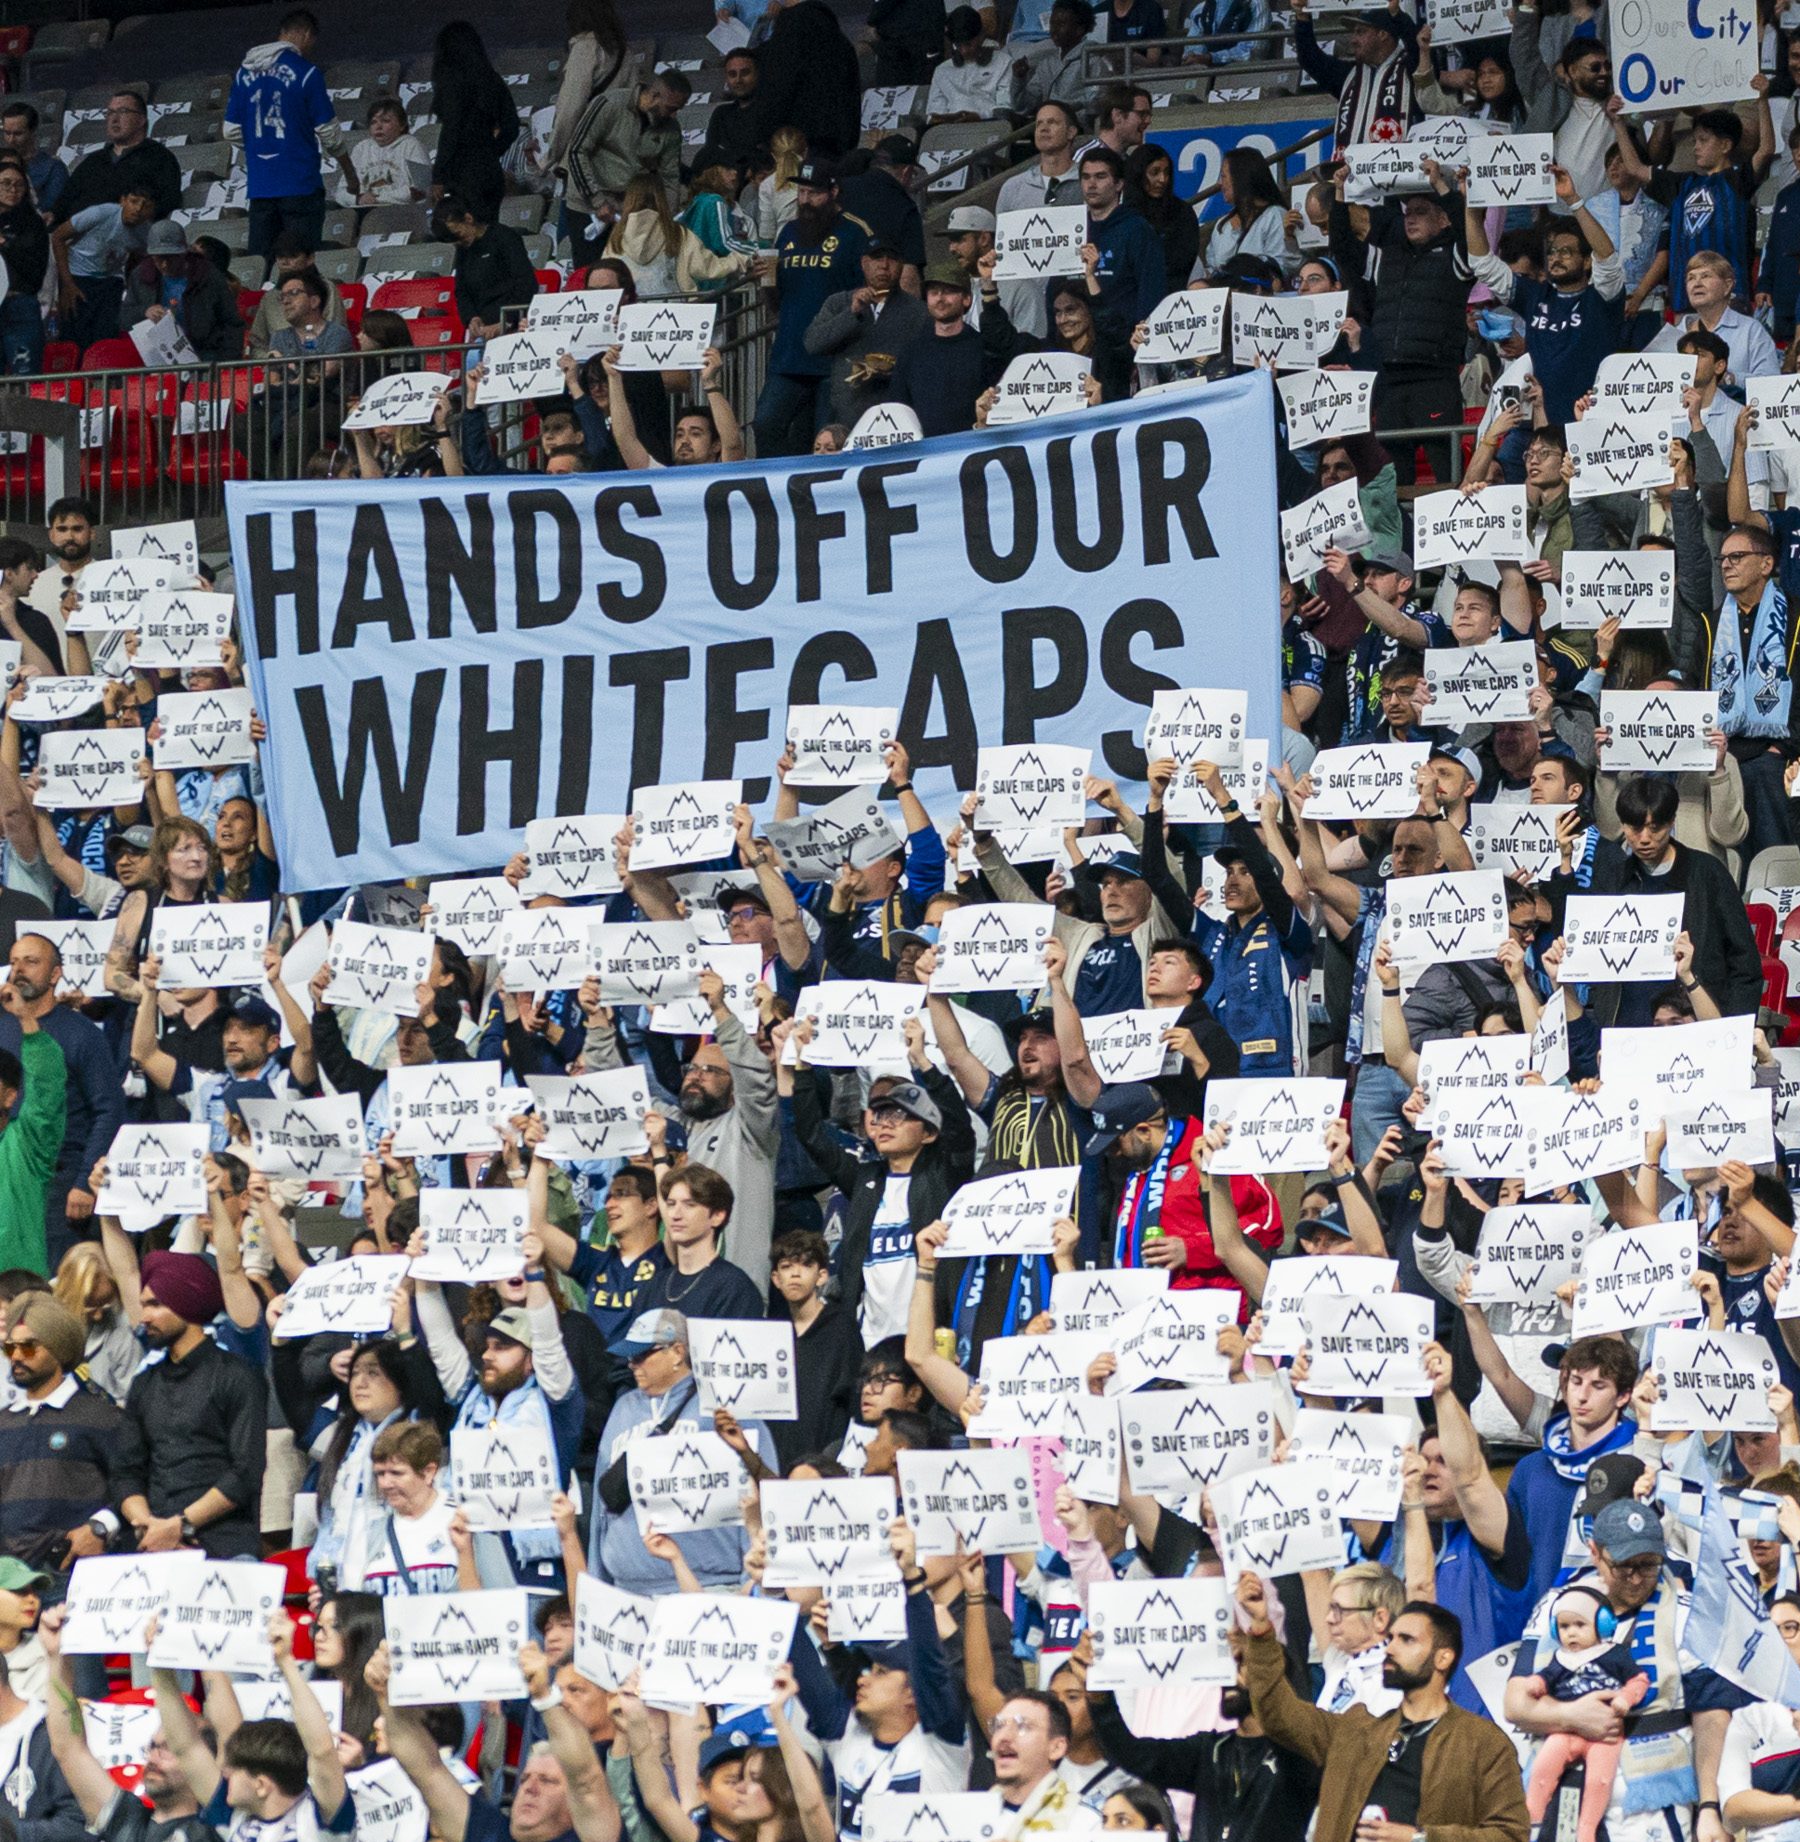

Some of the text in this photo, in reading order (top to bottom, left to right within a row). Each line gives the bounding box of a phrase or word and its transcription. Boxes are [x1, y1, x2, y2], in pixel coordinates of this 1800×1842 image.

[1687, 0, 1752, 46] City
[1619, 52, 1685, 103] Our
[250, 88, 286, 139] 14
[1476, 162, 1536, 178] SAVE THE CAPS
[1154, 315, 1207, 336] SAVE THE CAPS
[495, 357, 551, 376] SAVE THE CAPS
[1007, 381, 1072, 396] SAVE THE CAPS
[1604, 380, 1674, 397] SAVE THE CAPS
[1432, 515, 1506, 536] SAVE THE CAPS
[246, 416, 1220, 658] HANDS OFF OUR
[294, 598, 1186, 858] WHITECAPS
[1619, 723, 1695, 739] SAVE THE CAPS
[54, 760, 125, 778] SAVE THE CAPS
[992, 777, 1065, 795] SAVE THE CAPS
[1408, 907, 1485, 929] SAVE THE CAPS
[953, 938, 1029, 956] SAVE THE CAPS
[826, 1014, 894, 1030] SAVE THE CAPS
[409, 1099, 479, 1119] SAVE THE CAPS
[1682, 1122, 1747, 1136] SAVE THE CAPS
[872, 1233, 914, 1254] ELU
[1595, 1263, 1674, 1294] SAVE THE CAPS
[1321, 1336, 1409, 1354] SAVE THE CAPS
[1673, 1371, 1756, 1390] SAVE THE CAPS
[470, 1470, 535, 1490] SAVE THE CAPS
[1113, 1624, 1207, 1646] SAVE THE CAPS
